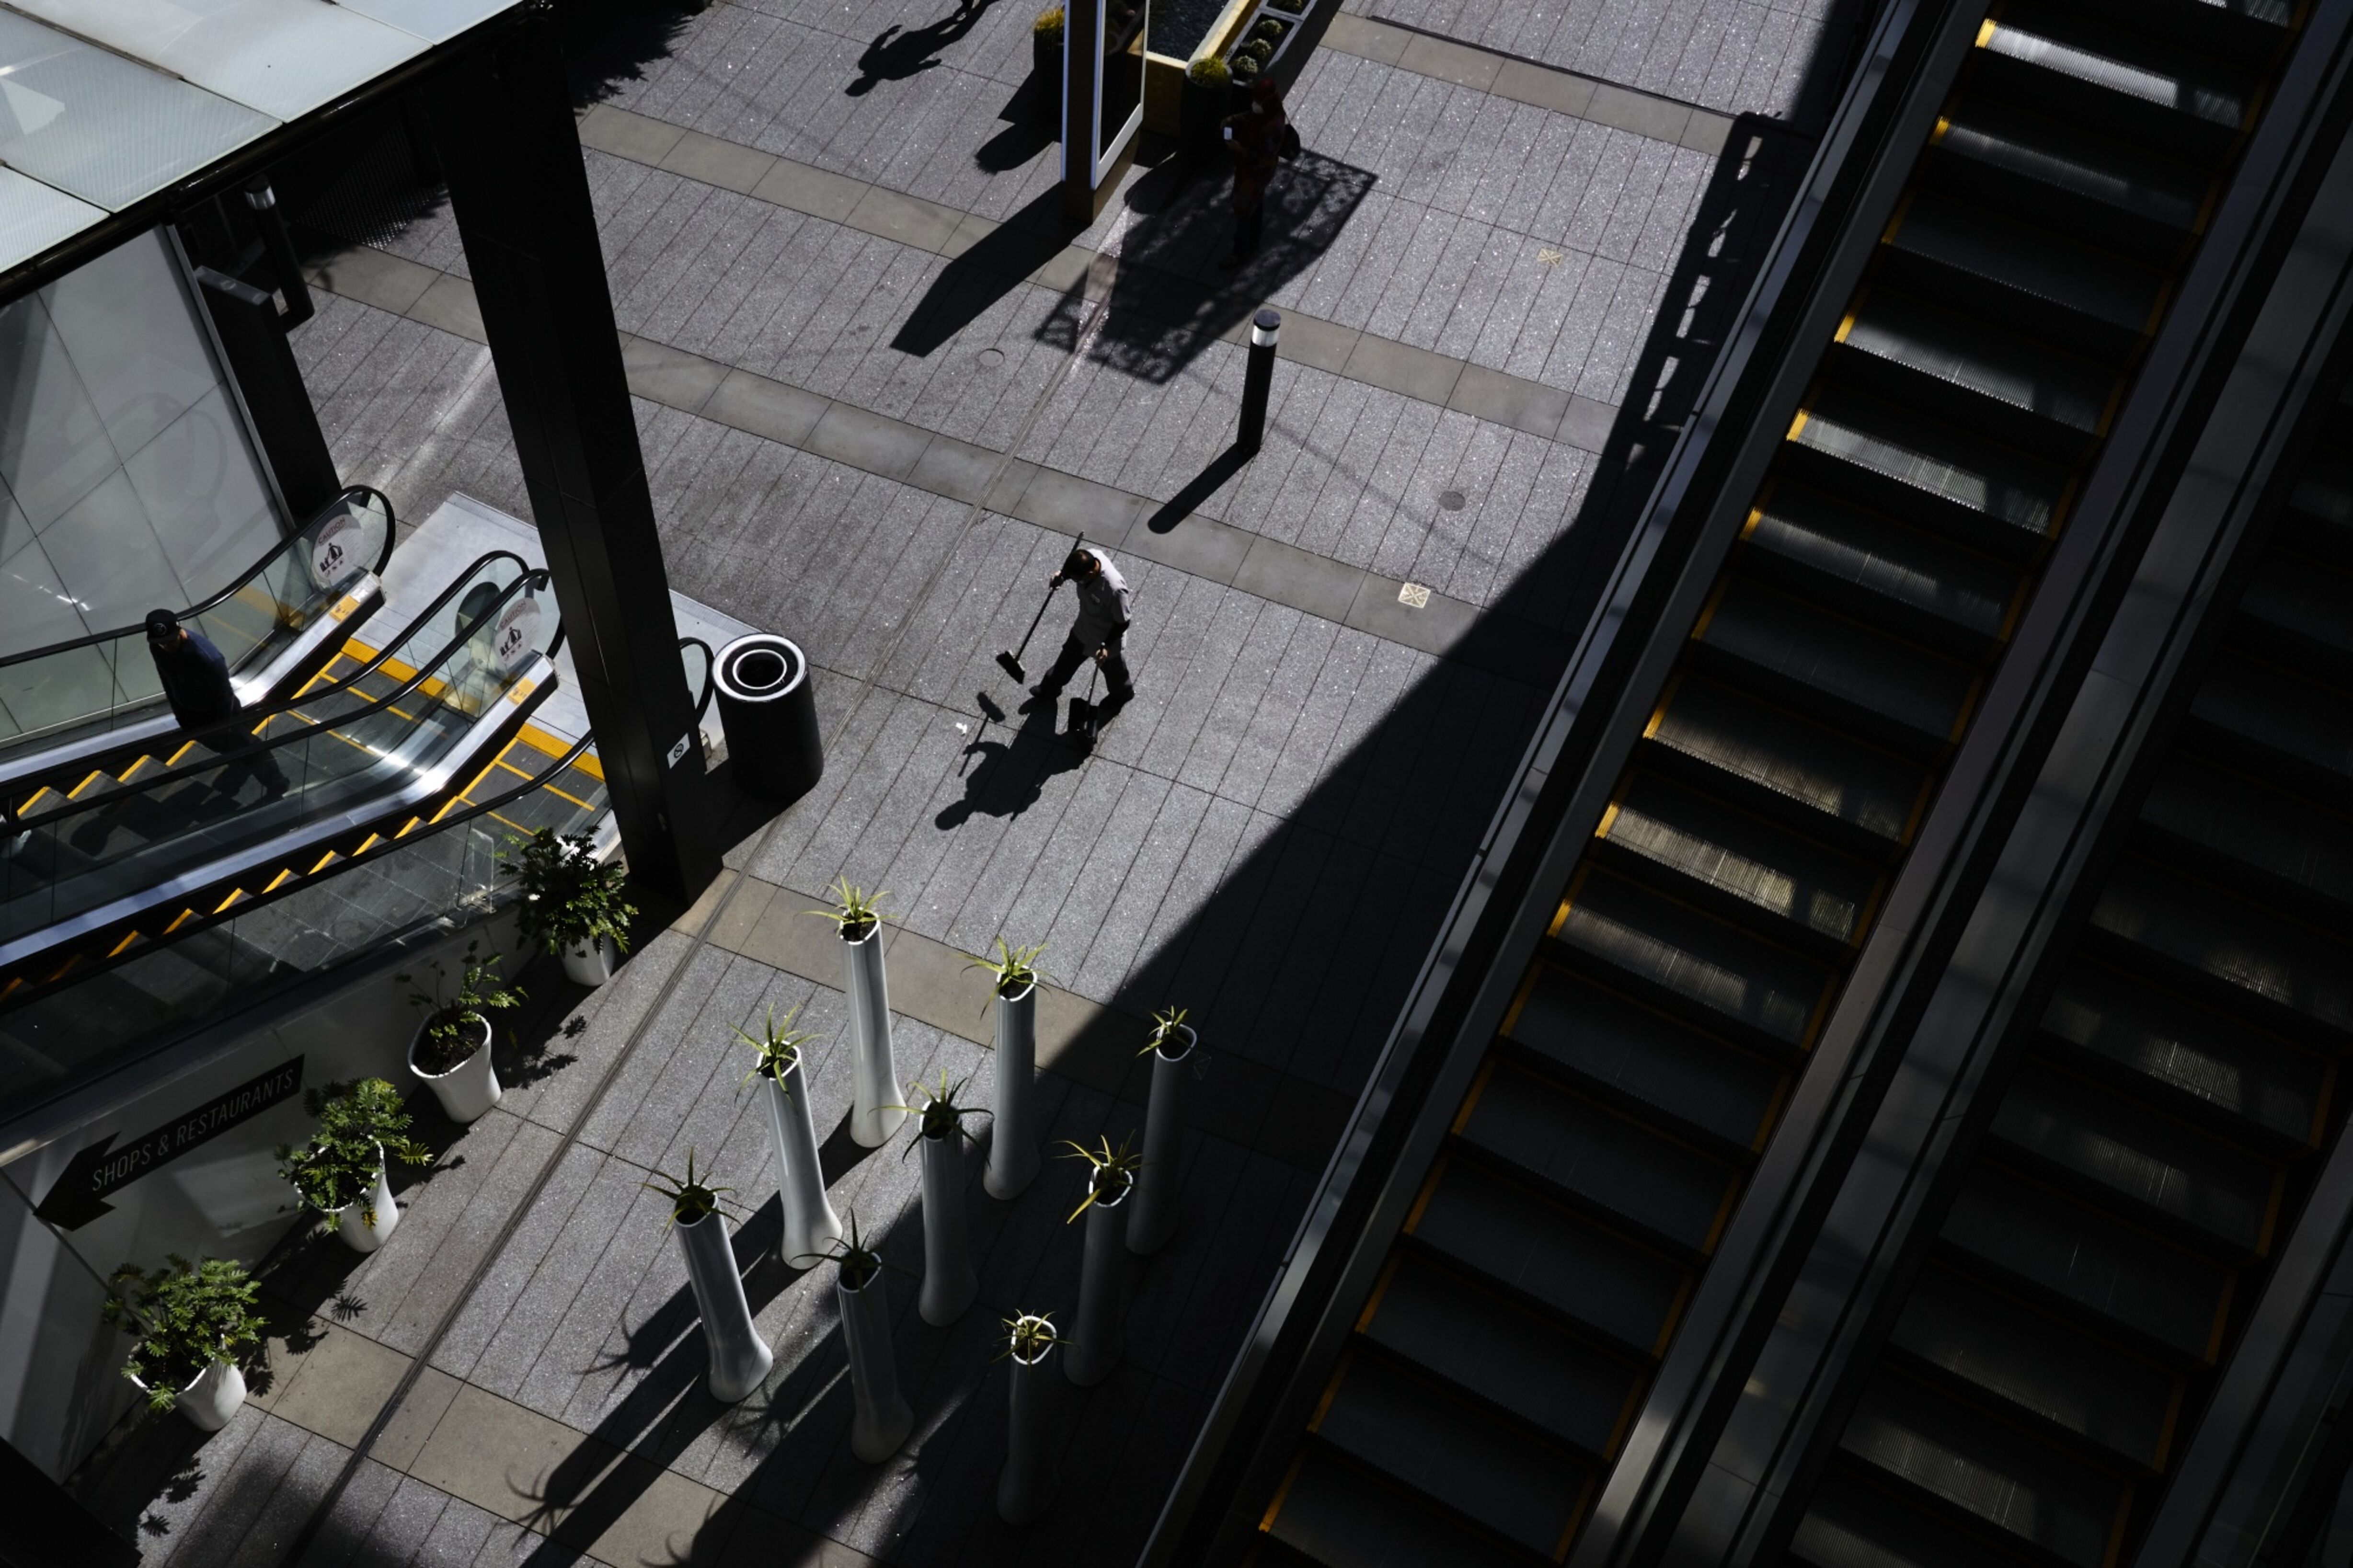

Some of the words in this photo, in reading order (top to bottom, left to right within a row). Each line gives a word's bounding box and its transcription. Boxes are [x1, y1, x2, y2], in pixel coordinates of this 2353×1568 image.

[318, 517, 345, 544] CAUTION
[500, 601, 527, 628] CAUTION
[92, 1144, 151, 1191] SHOPS
[158, 1134, 169, 1156] &
[176, 1068, 294, 1147] RESTAURANTS
